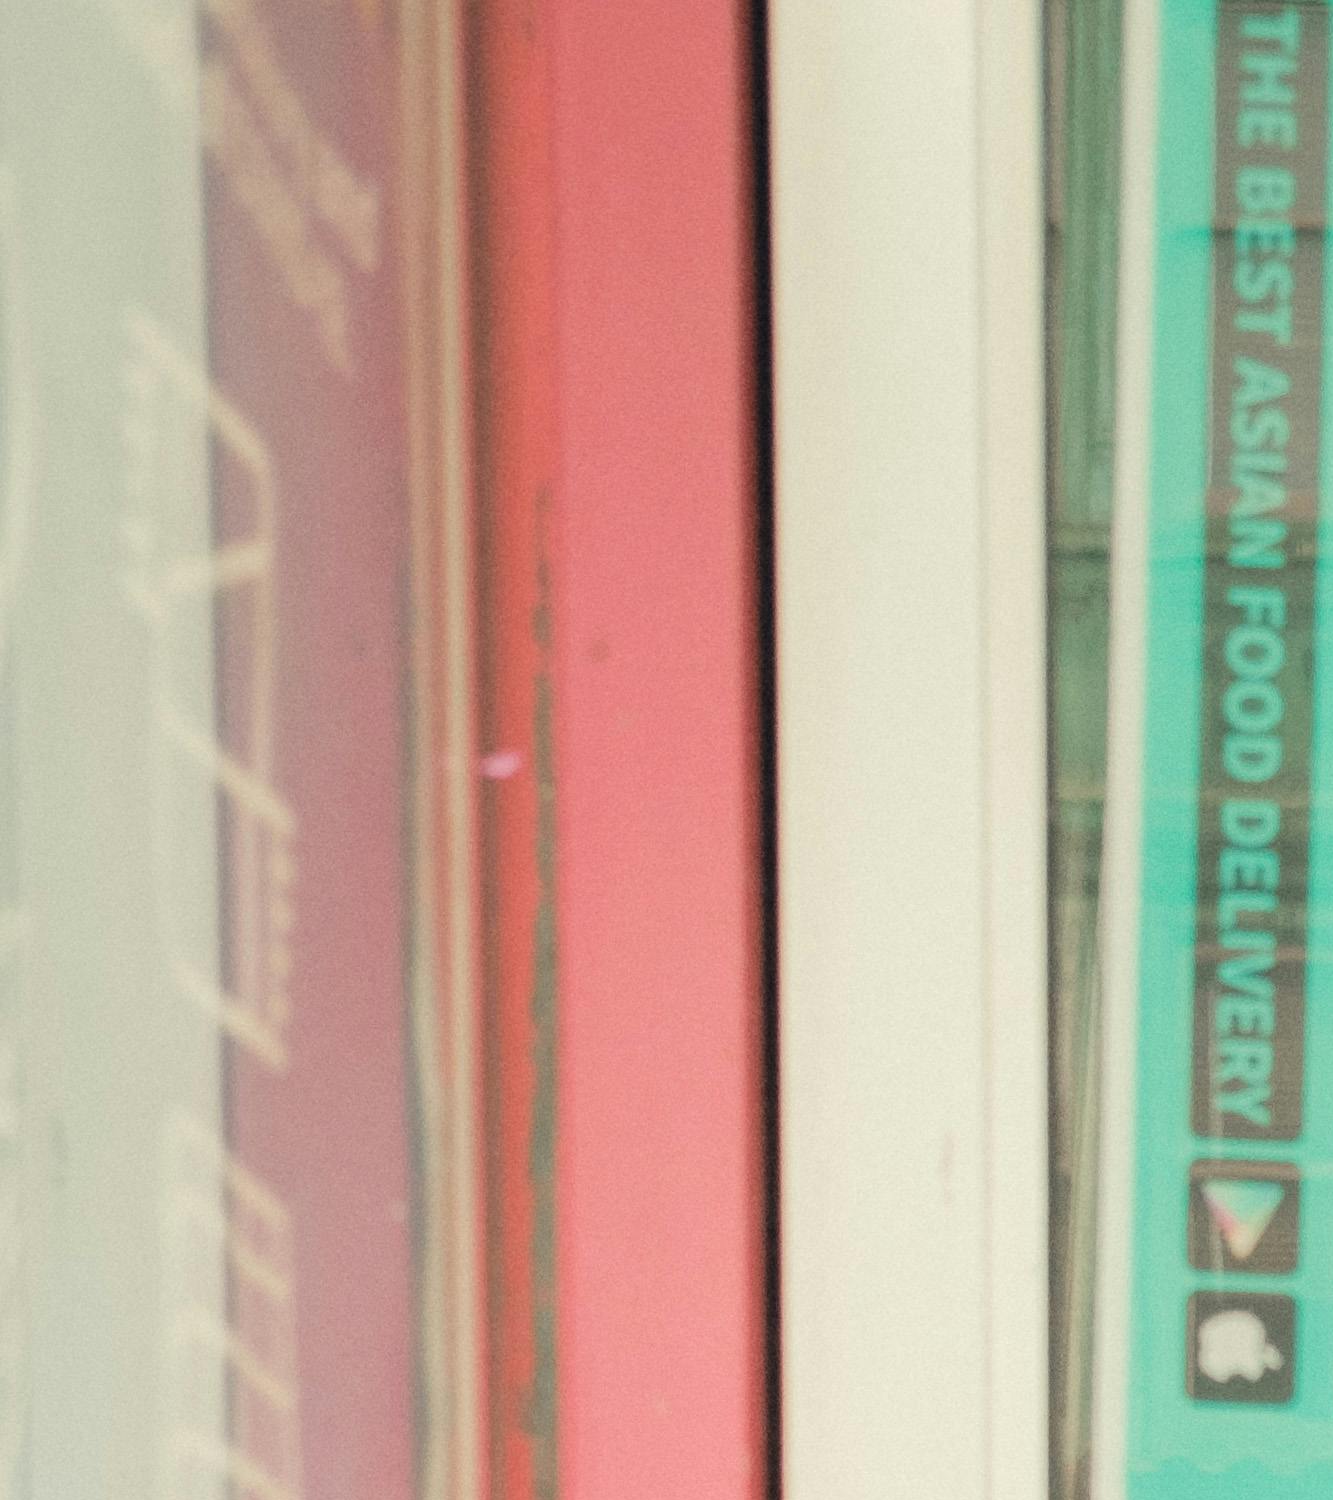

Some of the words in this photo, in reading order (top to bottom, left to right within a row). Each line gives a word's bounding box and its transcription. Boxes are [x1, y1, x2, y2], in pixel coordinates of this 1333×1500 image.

[1236, 6, 1301, 150] THE
[1233, 166, 1295, 347] BEST
[1227, 356, 1291, 569] ASIAN
[1222, 587, 1287, 783] FOOD
[1215, 798, 1281, 1127] DELIVERY
